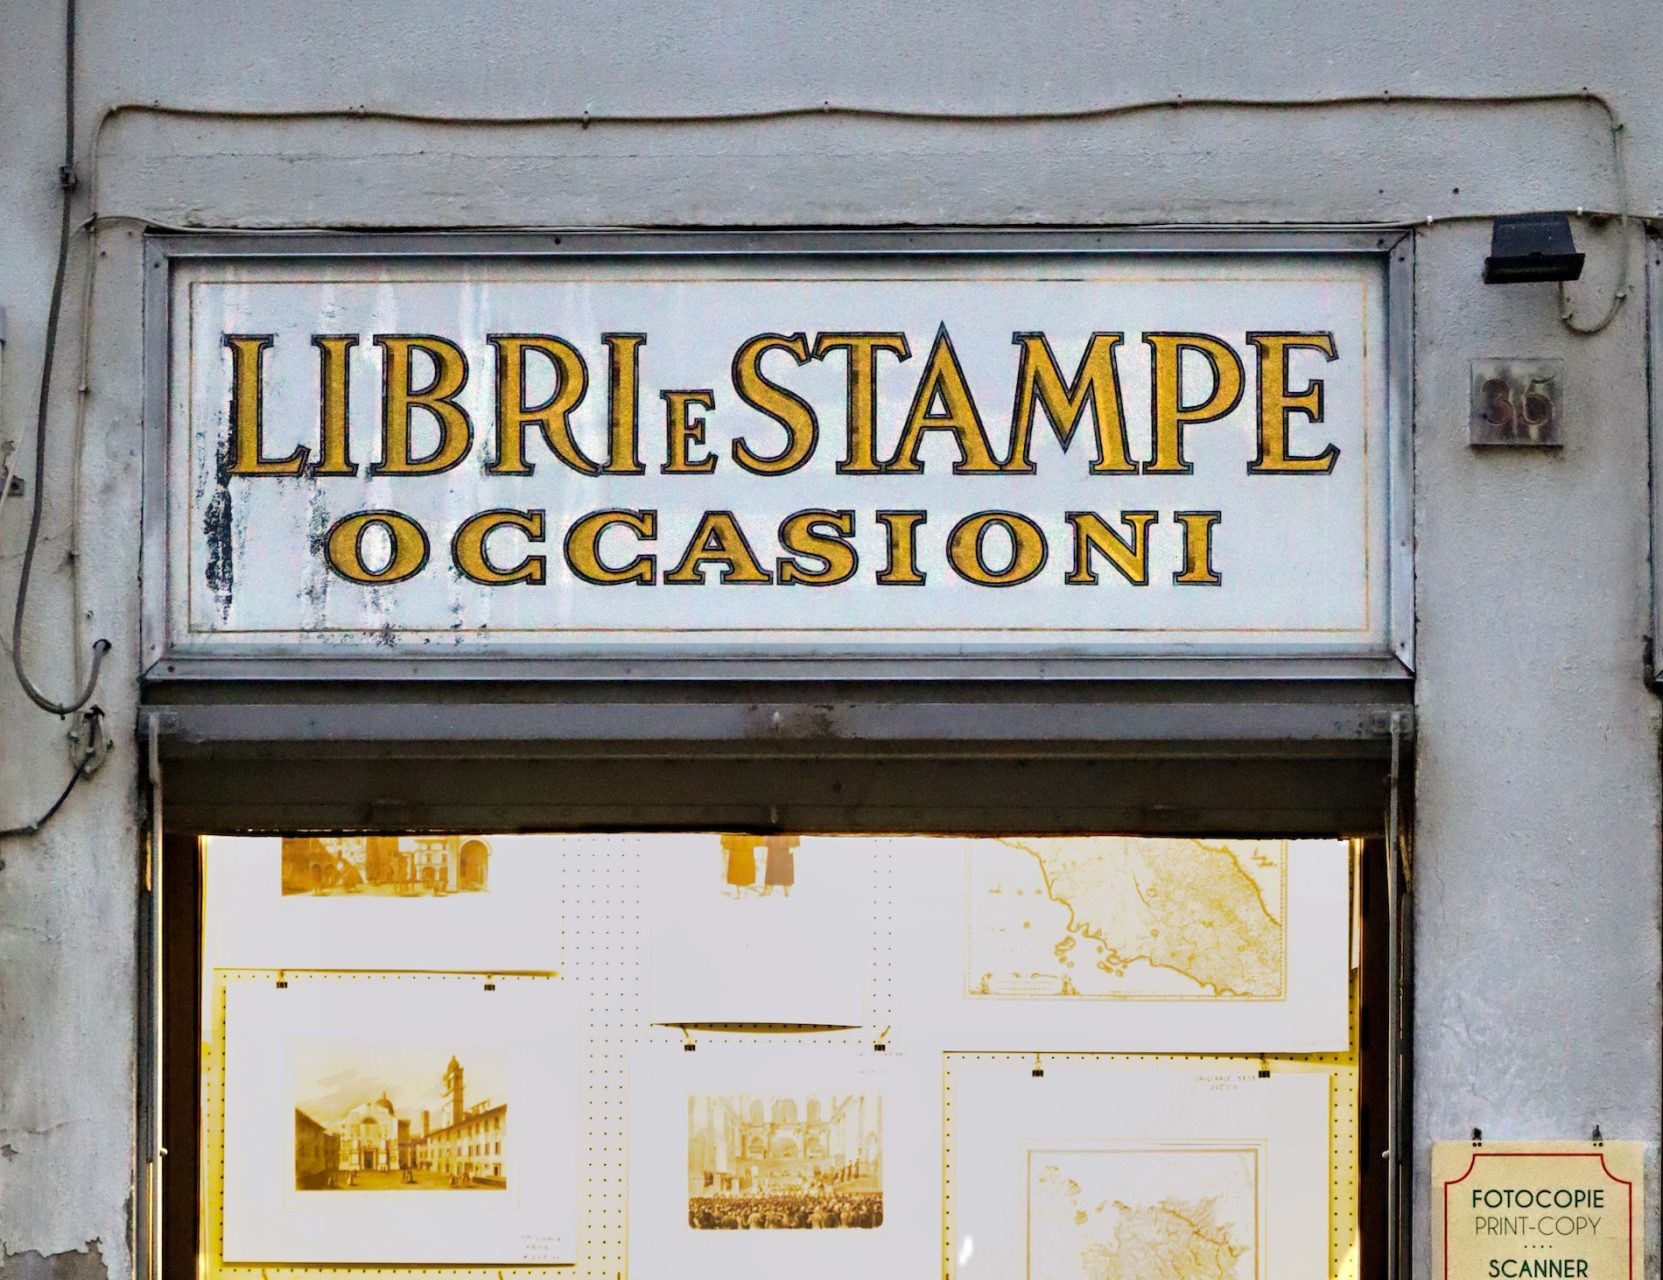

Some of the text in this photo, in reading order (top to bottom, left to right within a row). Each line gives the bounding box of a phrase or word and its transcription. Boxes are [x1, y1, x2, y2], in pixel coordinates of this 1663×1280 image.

[226, 332, 648, 478] LIBRI
[732, 321, 1341, 478] STAMPE
[327, 508, 1223, 588] OCCASIONI
[1472, 1189, 1605, 1209] FOTOCOPIE
[1475, 1216, 1602, 1236] PRINT-COPY
[1488, 1259, 1588, 1279] SCANNER
